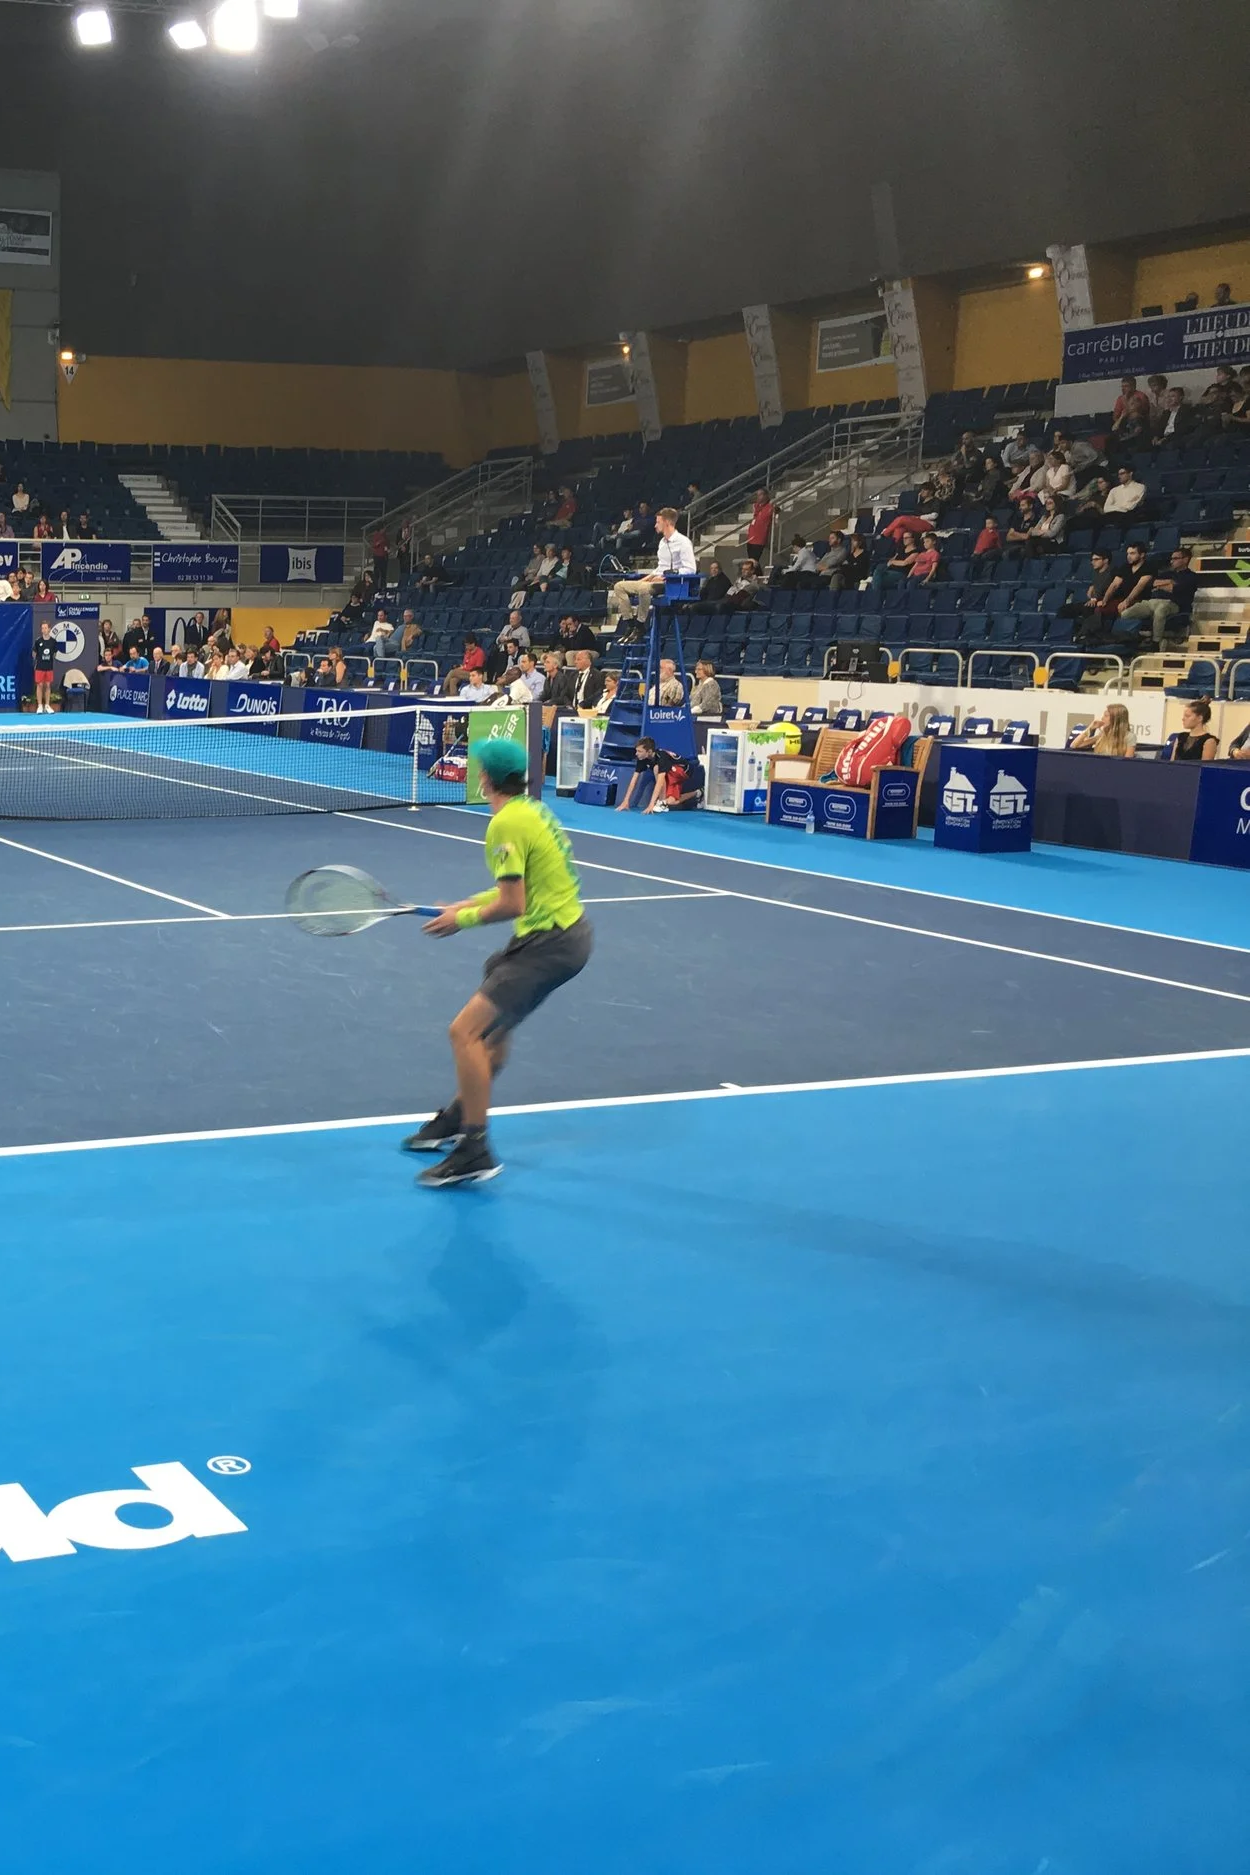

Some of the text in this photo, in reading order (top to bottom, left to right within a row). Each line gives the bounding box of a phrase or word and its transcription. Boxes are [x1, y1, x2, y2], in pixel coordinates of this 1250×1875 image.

[1067, 331, 1164, 357] carréblanc
[65, 366, 75, 375] 14
[161, 552, 202, 566] Christophe
[291, 556, 312, 570] ibis
[117, 689, 133, 701] PLACE
[650, 709, 675, 720] Loiret
